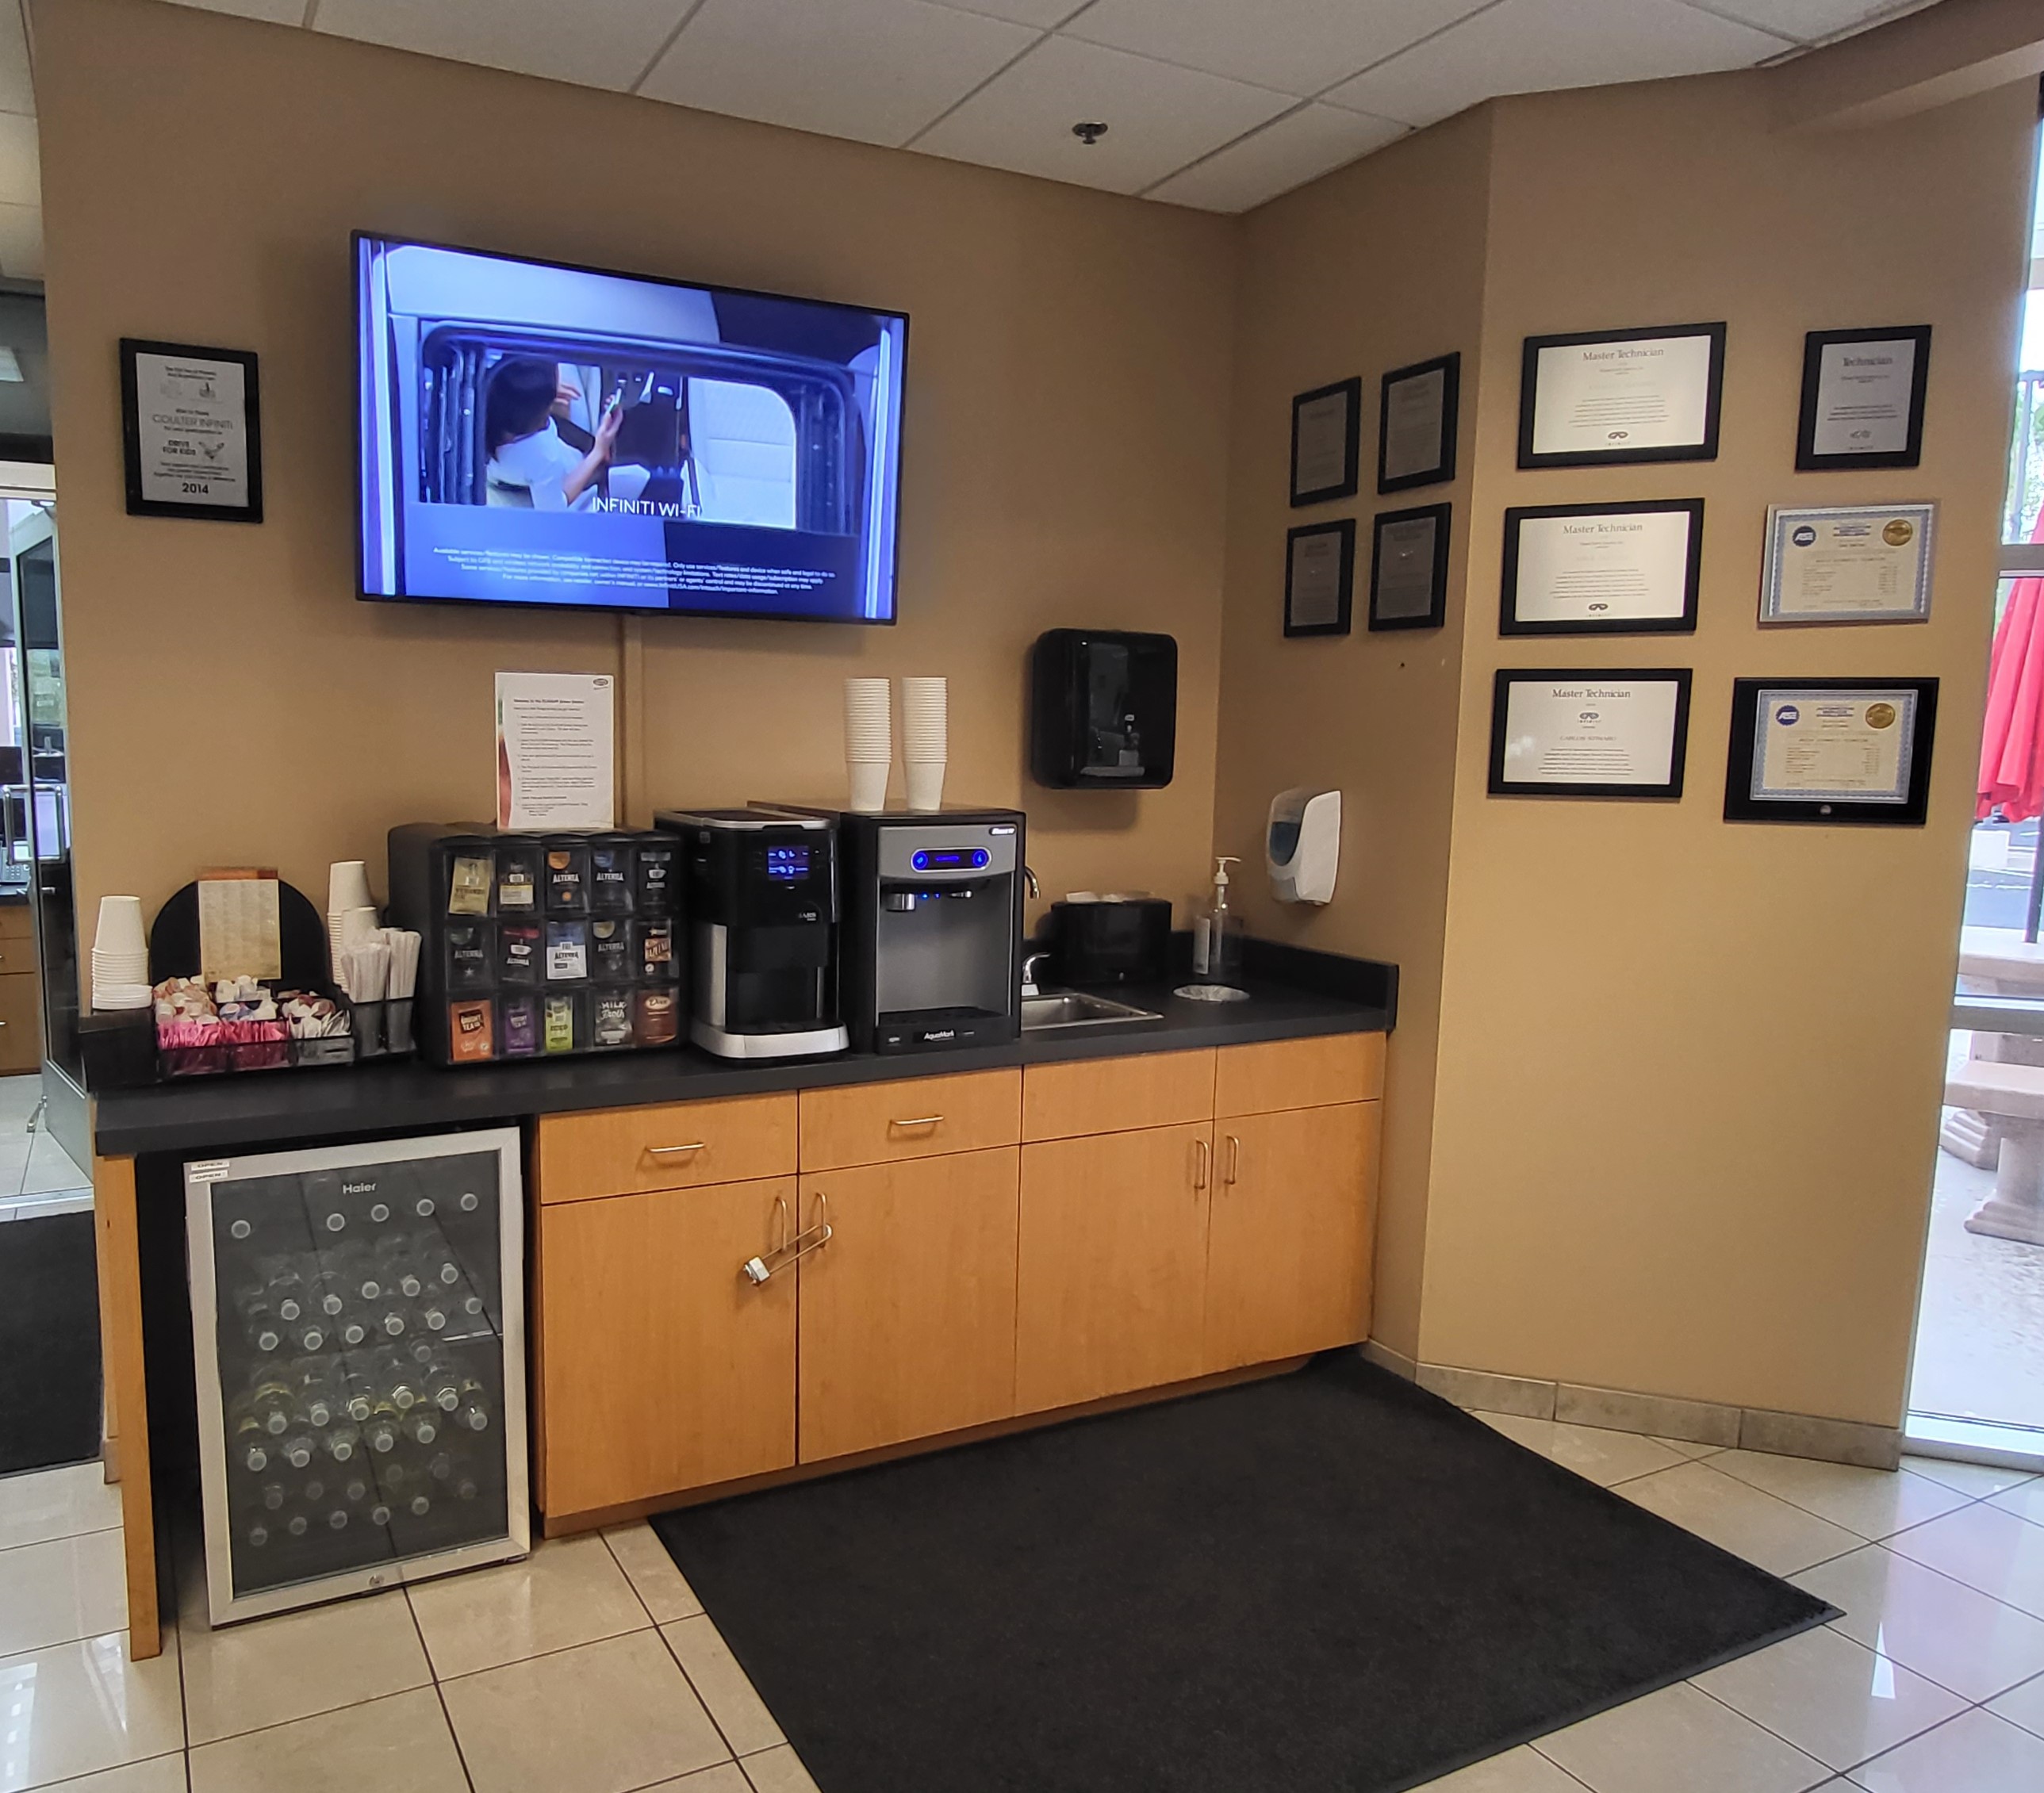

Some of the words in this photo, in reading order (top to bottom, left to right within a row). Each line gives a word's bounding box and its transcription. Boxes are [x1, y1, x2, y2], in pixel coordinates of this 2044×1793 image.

[1582, 351, 1616, 362] Master
[1617, 347, 1664, 358] Technician
[182, 482, 209, 494] 2014
[592, 496, 655, 515] INFINITI
[658, 501, 700, 518] WI-FI
[1563, 524, 1595, 534] Master
[1597, 523, 1643, 533] Technician
[1552, 688, 1583, 698] Master
[1585, 688, 1631, 699] Technician
[601, 1001, 627, 1010] MILK
[342, 1182, 377, 1194] Haier
